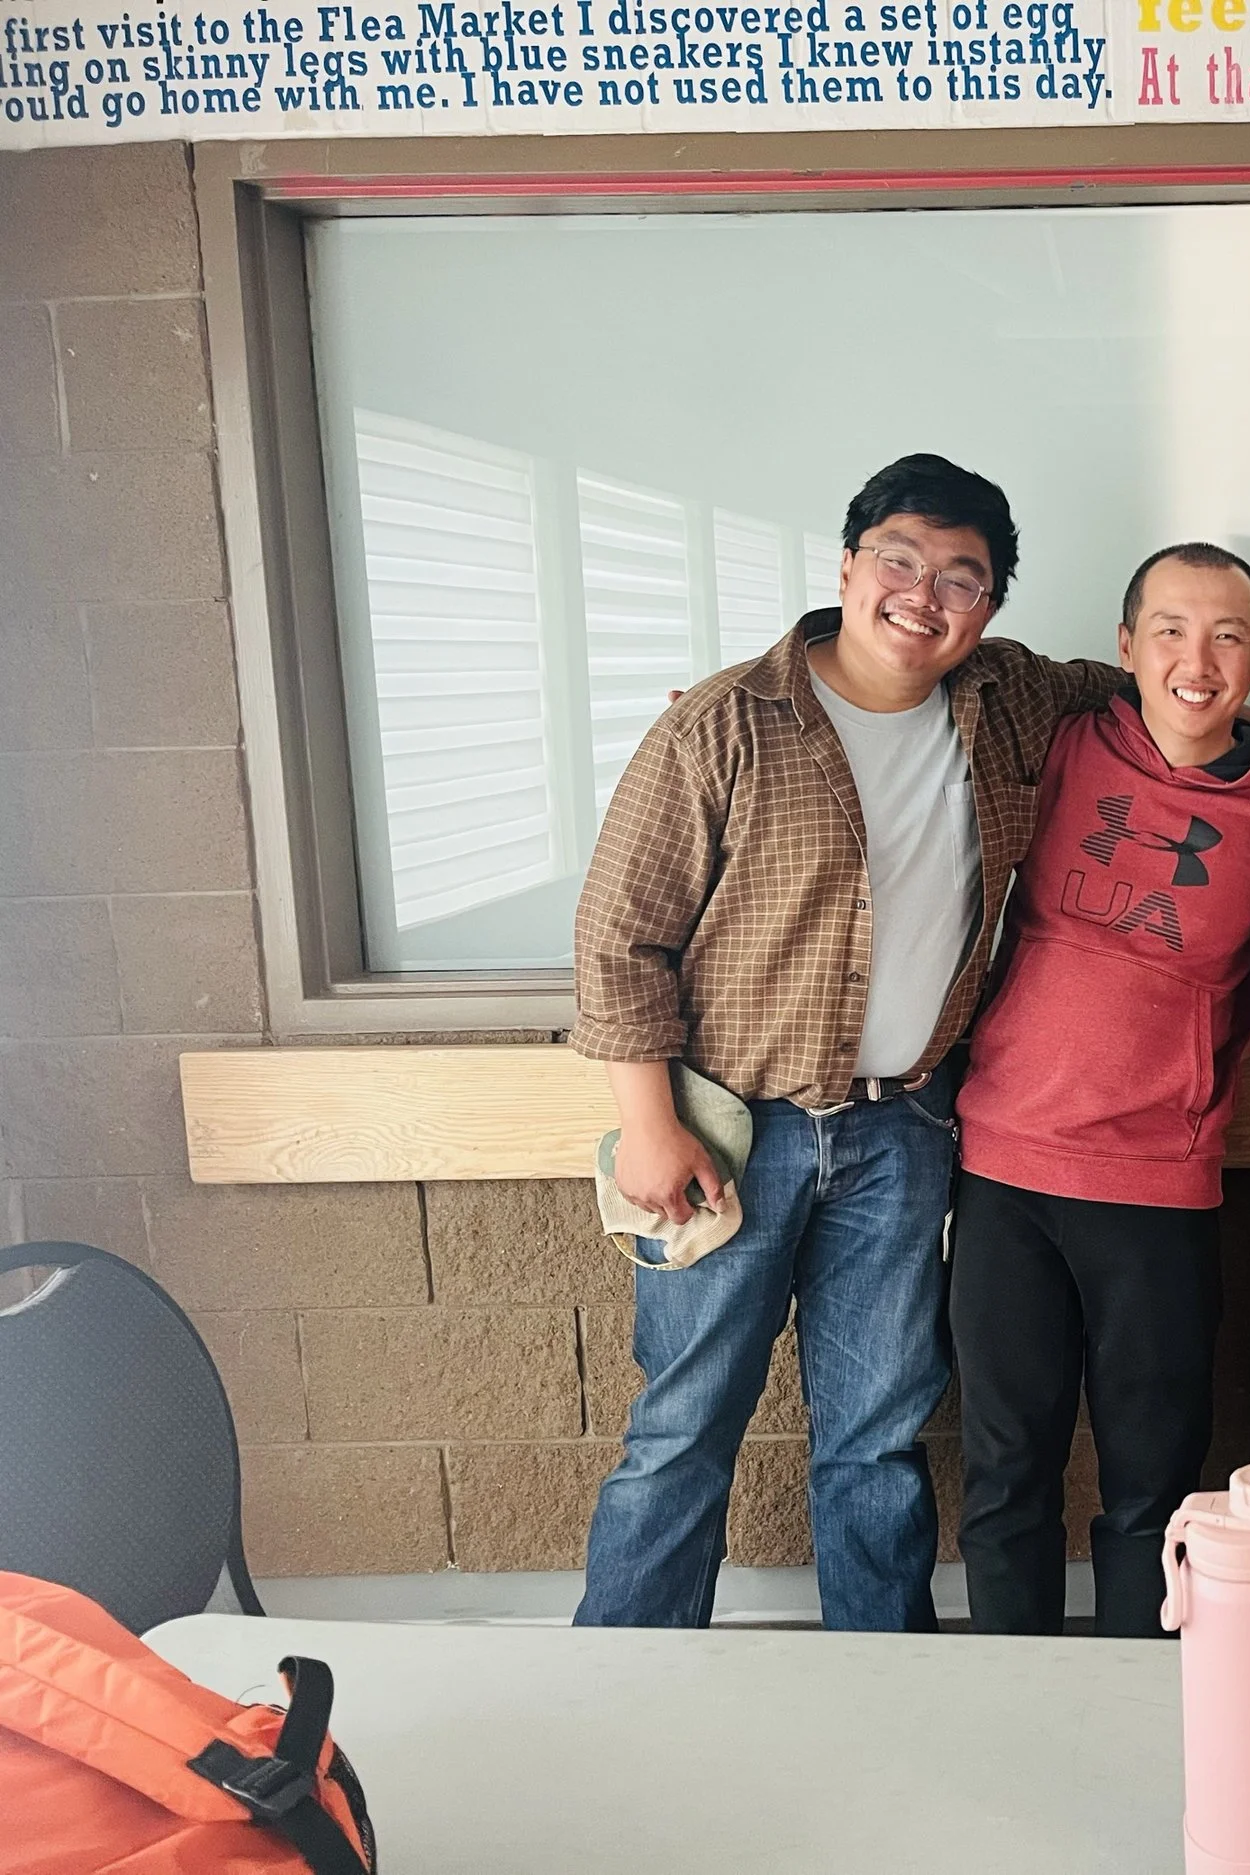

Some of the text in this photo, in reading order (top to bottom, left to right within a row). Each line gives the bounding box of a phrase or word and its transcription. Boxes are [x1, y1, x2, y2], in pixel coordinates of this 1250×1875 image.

[4, 0, 1074, 53] first visit to the Flea Market I discovered a set of egg
[85, 58, 130, 84] on
[143, 44, 270, 88] skinny
[283, 42, 368, 85] legs
[381, 37, 468, 75] with
[480, 35, 567, 71] blue
[582, 33, 763, 70] sneakers
[777, 33, 794, 68] I
[807, 32, 913, 67] knew
[928, 28, 1106, 73] instantly
[1138, 47, 1181, 105] At
[0, 64, 1112, 128] ould go home with me. I have not used them to this day.
